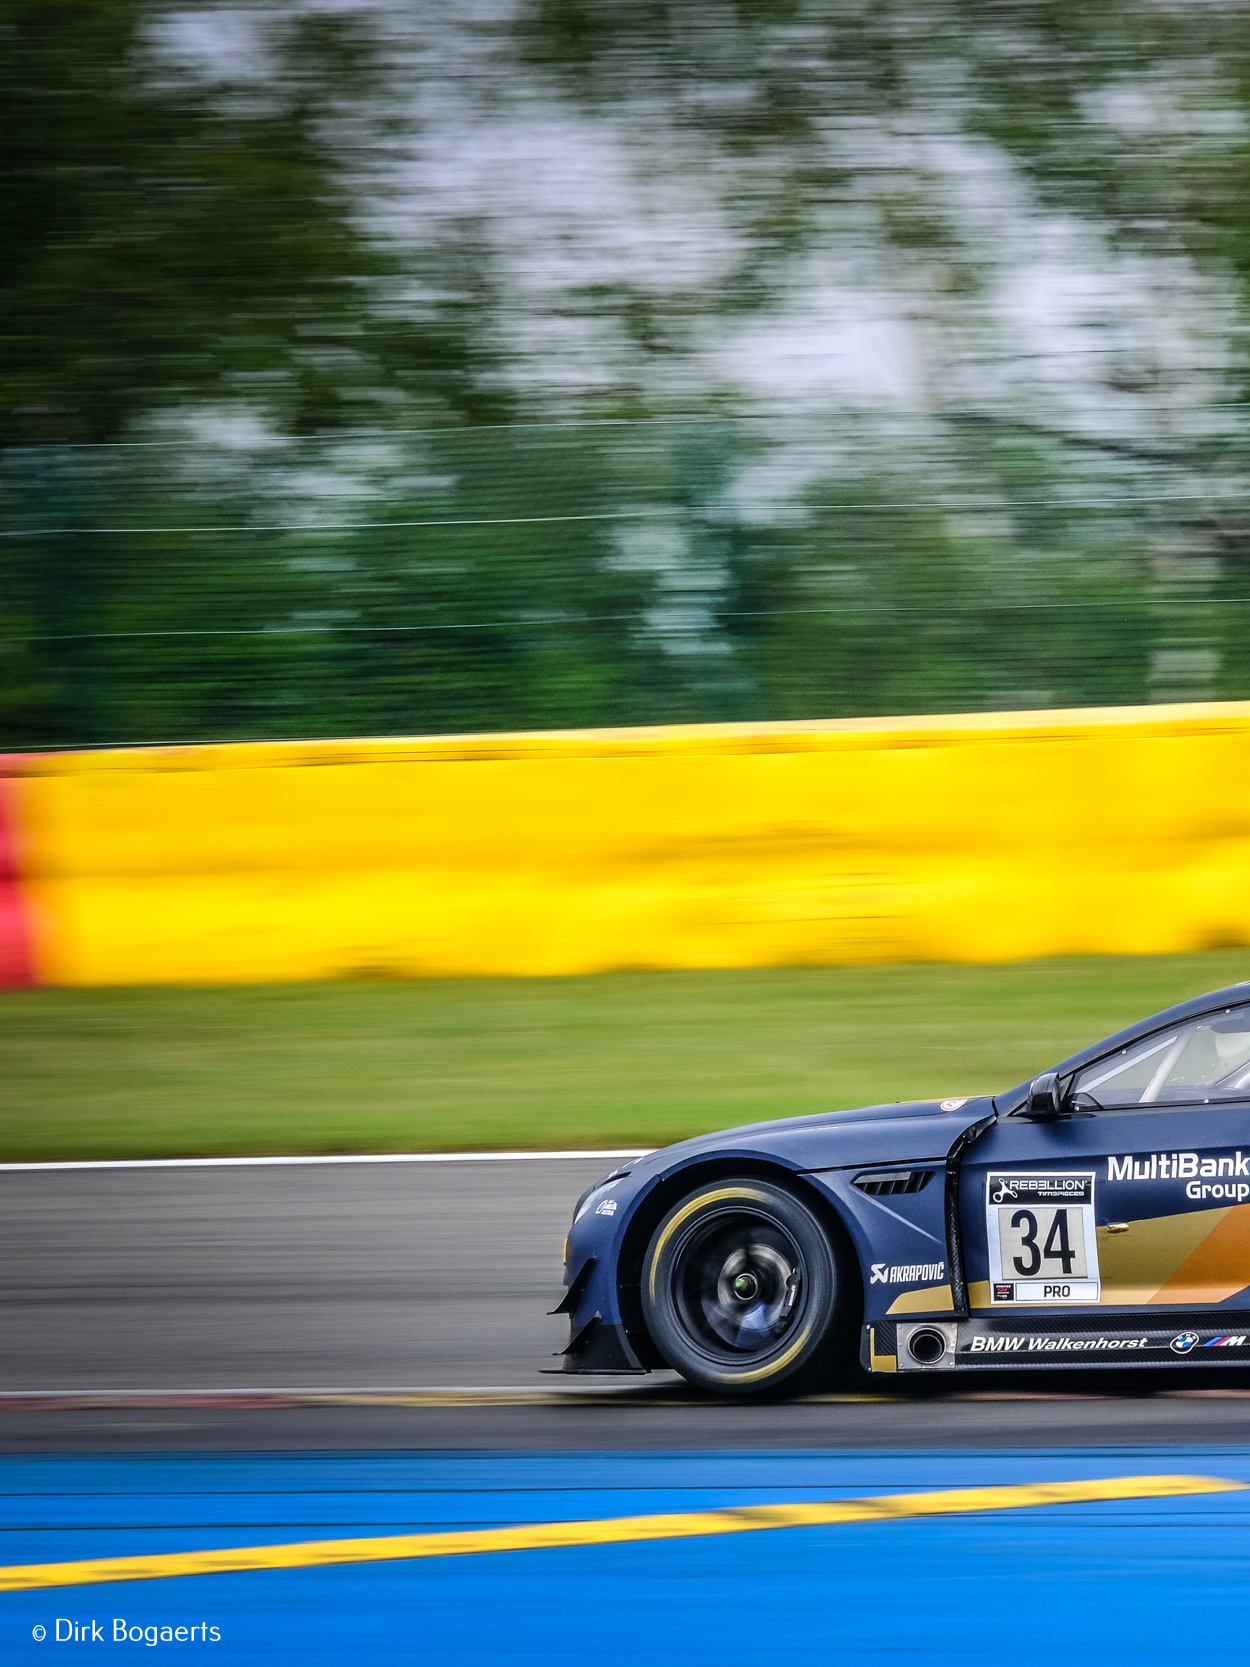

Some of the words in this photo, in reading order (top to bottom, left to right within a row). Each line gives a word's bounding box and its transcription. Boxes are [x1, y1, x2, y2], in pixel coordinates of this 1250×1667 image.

[1107, 1151, 1250, 1181] MultiBank
[1009, 1180, 1085, 1191] REBELLION
[1186, 1180, 1250, 1202] Group
[1010, 1208, 1076, 1277] 34
[1043, 1284, 1071, 1298] PRO
[970, 1336, 1024, 1351] BMW
[1028, 1337, 1148, 1351] Walkenhorst
